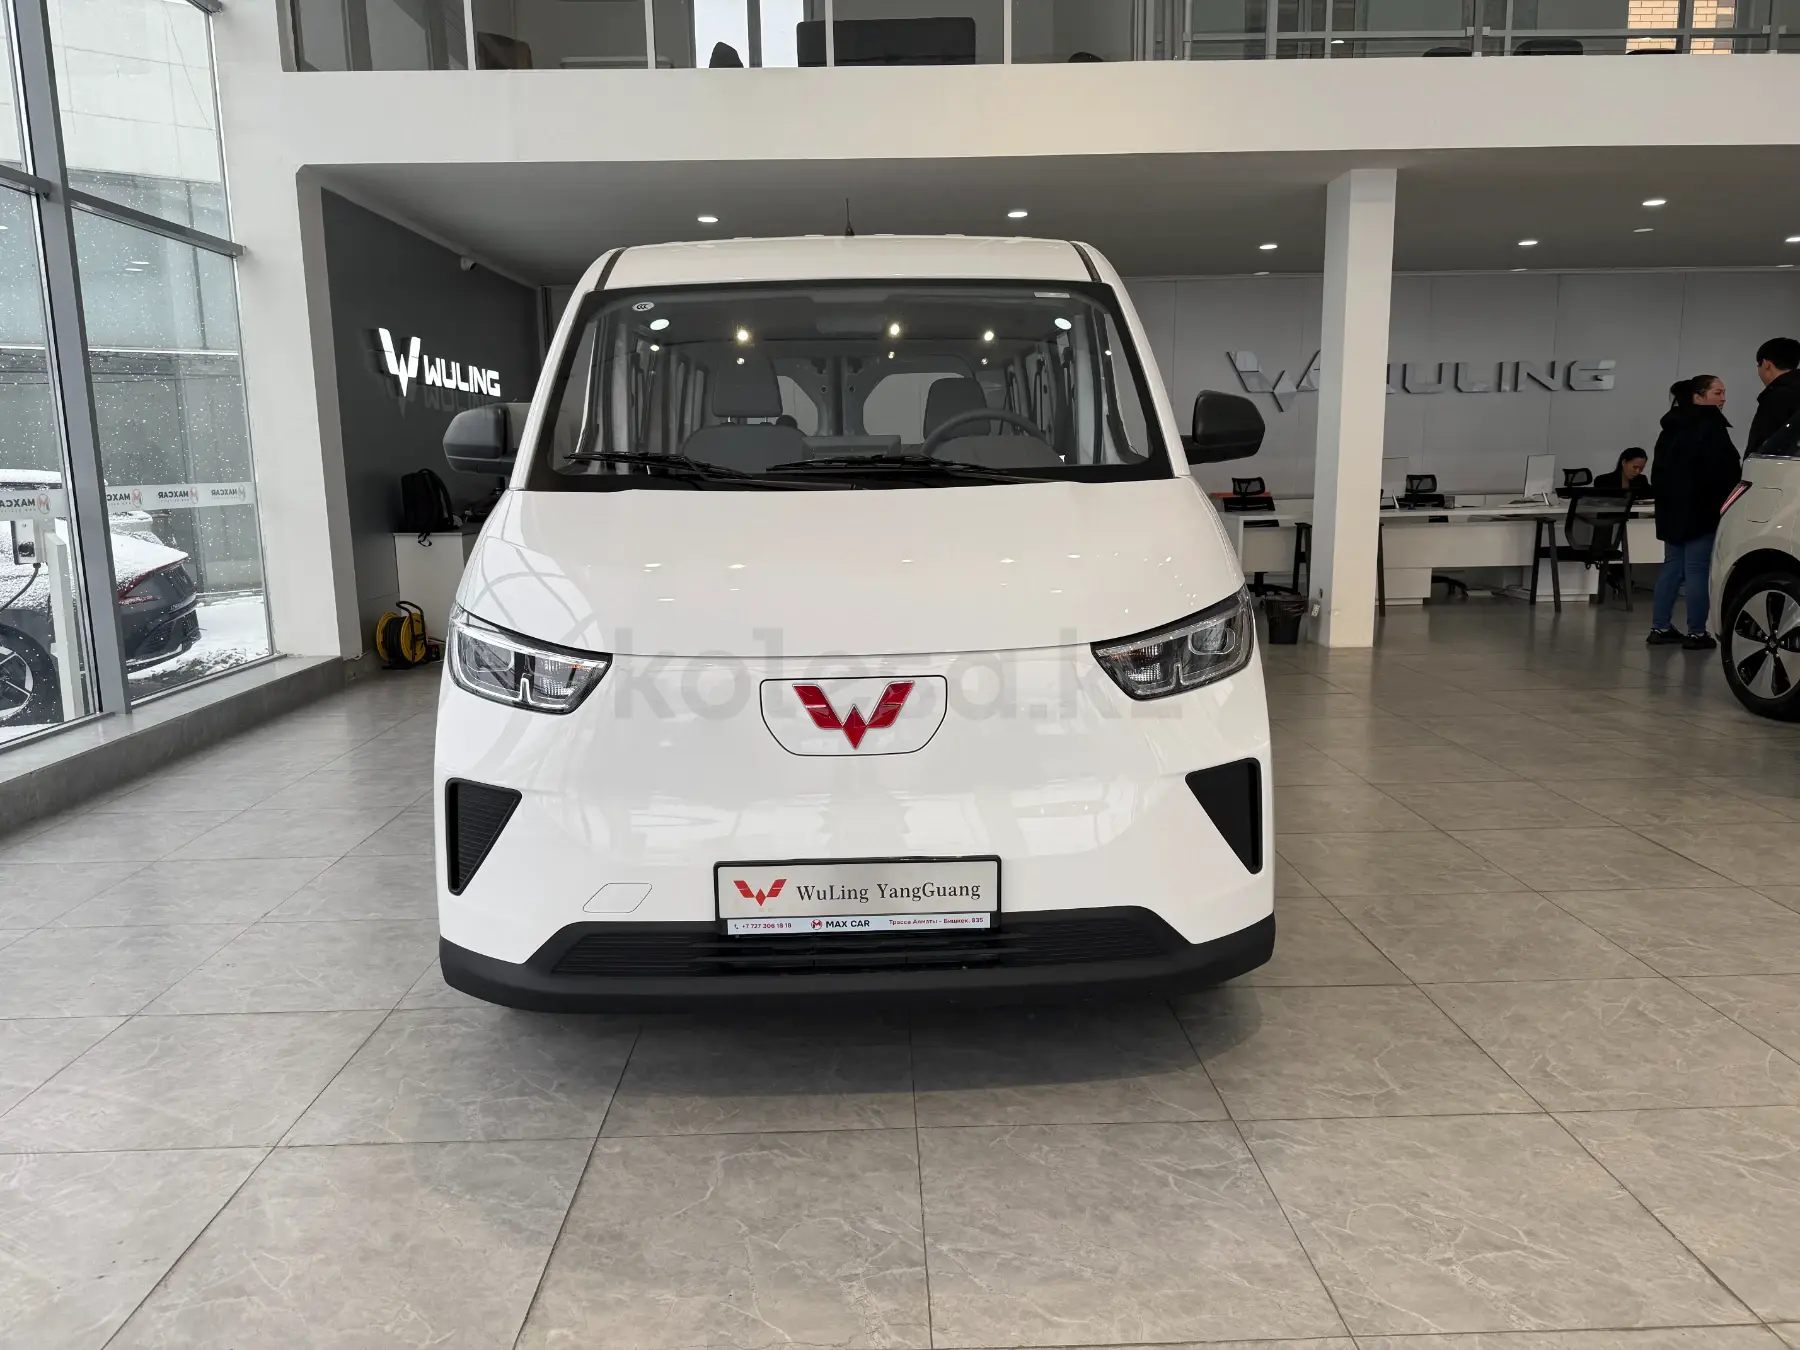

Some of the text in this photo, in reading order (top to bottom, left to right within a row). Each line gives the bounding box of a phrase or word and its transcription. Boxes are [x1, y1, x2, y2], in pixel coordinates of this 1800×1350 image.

[423, 354, 501, 397] WULING
[1386, 360, 1617, 395] ULING
[796, 882, 981, 903] WuLing YangGuang
[825, 920, 847, 928] MAX
[850, 919, 870, 928] CAR
